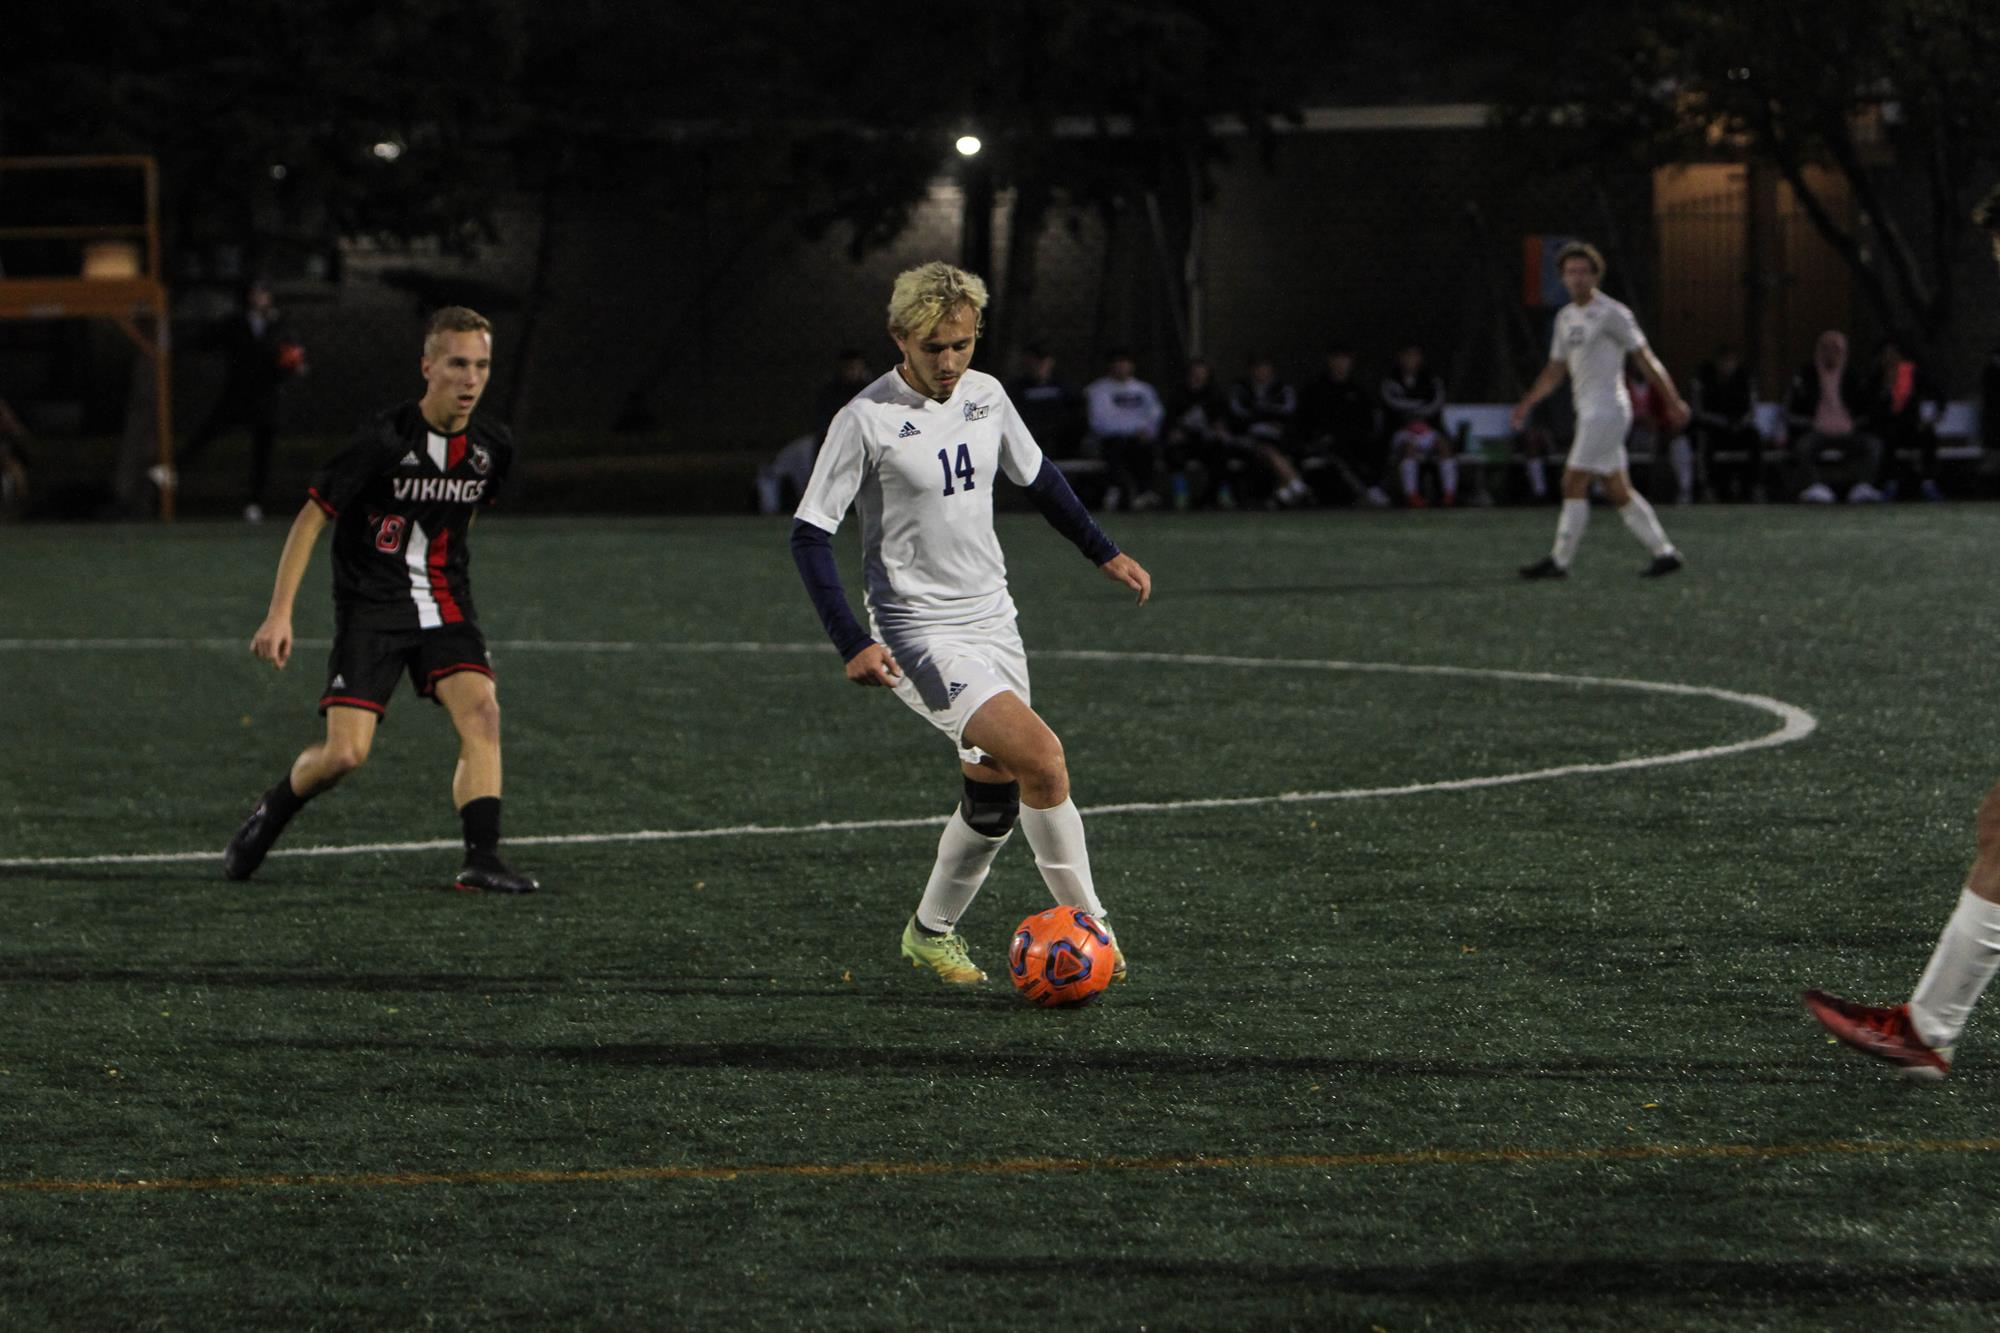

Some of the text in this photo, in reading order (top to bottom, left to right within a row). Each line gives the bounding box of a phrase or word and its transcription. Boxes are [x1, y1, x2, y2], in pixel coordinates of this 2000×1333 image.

[898, 430, 921, 439] adidas
[937, 443, 975, 497] 14
[393, 477, 487, 502] VIKINGS
